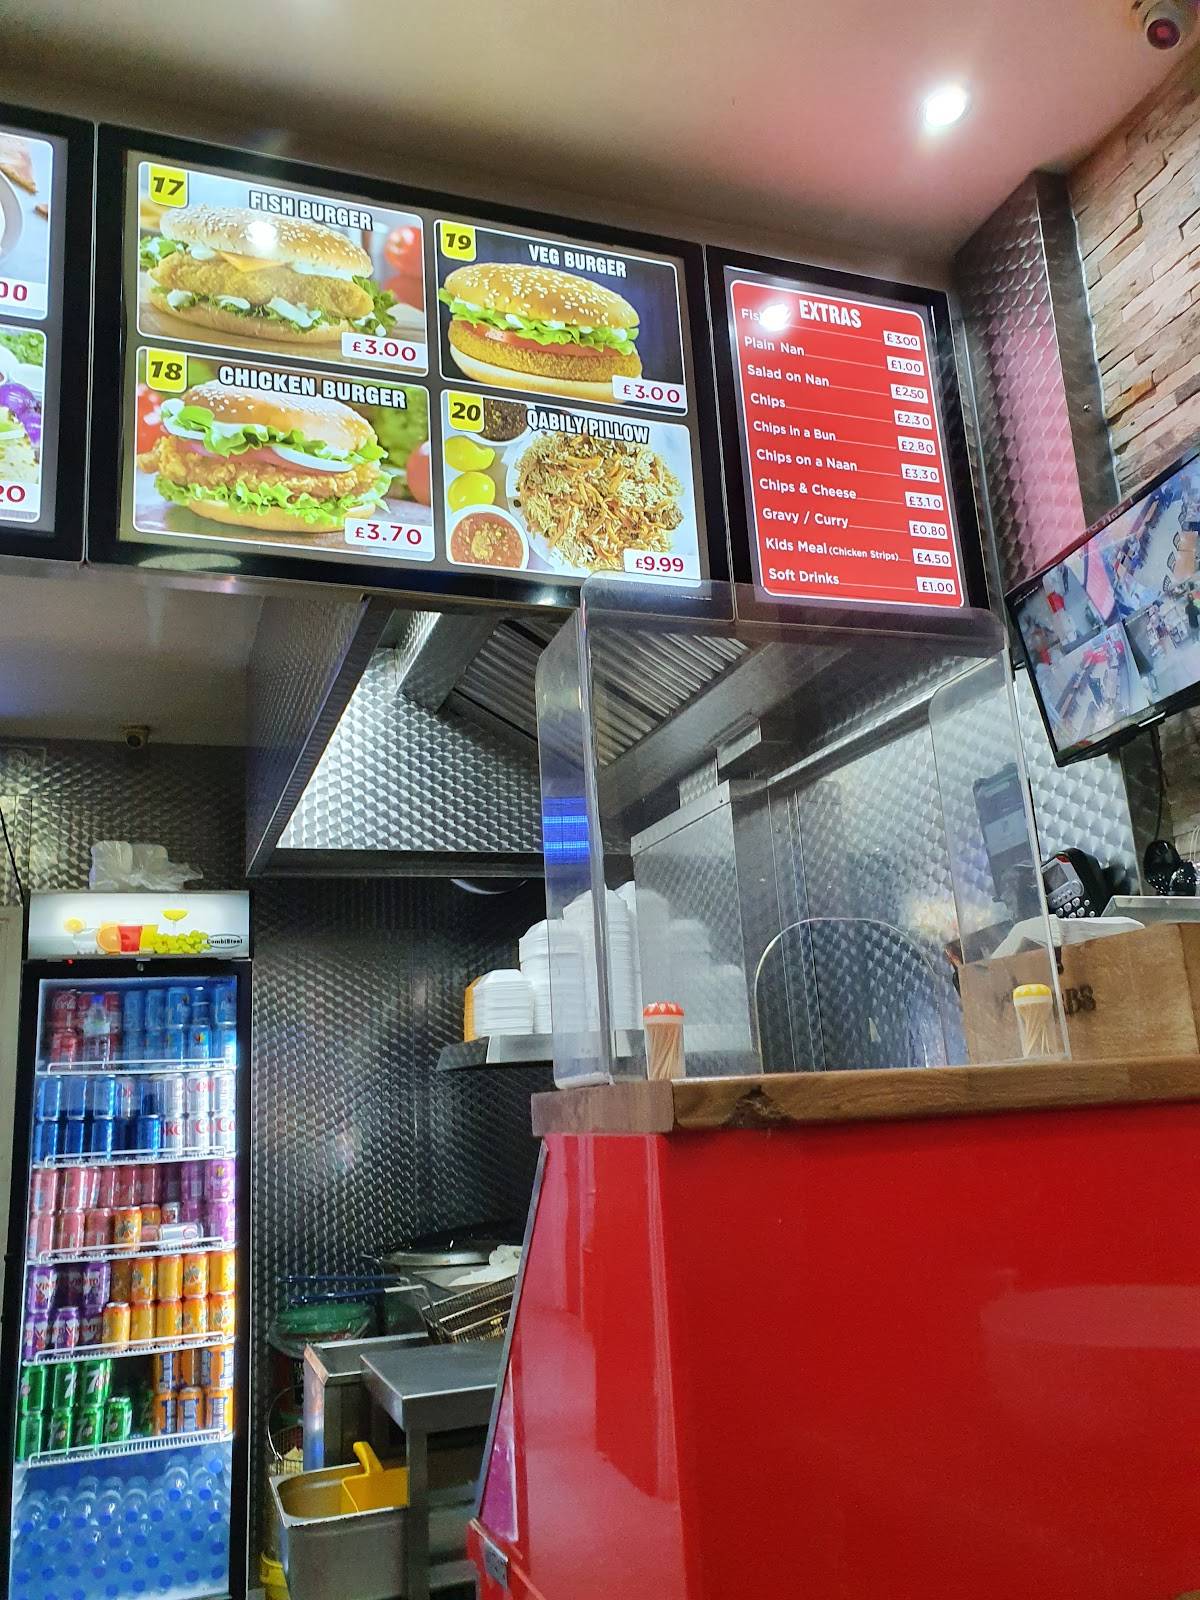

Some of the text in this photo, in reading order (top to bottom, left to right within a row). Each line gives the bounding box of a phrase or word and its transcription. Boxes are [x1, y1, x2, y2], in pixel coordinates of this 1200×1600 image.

[153, 176, 184, 196] 17
[250, 191, 373, 231] FISH BURGER
[446, 233, 471, 250] 19
[529, 244, 627, 278] VEG BURGER
[799, 299, 862, 329] EXTRAS
[352, 338, 417, 362] £3.00
[744, 336, 805, 356] Plain Nan
[151, 361, 183, 381] 18
[747, 364, 830, 387] Salad on Nan
[890, 359, 921, 373] £1.00
[218, 366, 407, 409] CHICKEN BURGER
[623, 384, 680, 403] £3.00
[750, 393, 786, 409] Chips
[452, 402, 481, 421] 20
[897, 413, 930, 427] £2.30
[526, 409, 650, 444] QABILY PILLOW
[753, 420, 787, 436] Chips
[803, 429, 811, 438] a
[813, 428, 837, 441] Bun
[901, 440, 934, 454] £2.80
[756, 448, 858, 472] Chips on a Naan
[905, 468, 938, 482] £3.30
[759, 478, 857, 500] Chips & Cheese
[909, 496, 942, 509] £3.10
[762, 507, 849, 529] Gravy / Curry
[354, 523, 422, 545] £3.70
[912, 523, 946, 537] £0.80
[765, 537, 900, 562] Kids Meal (Chicken Strips)
[917, 552, 949, 566] £4.50
[635, 555, 684, 573] £9.99
[768, 567, 840, 586] Soft Drinks
[922, 581, 953, 594] £1.00
